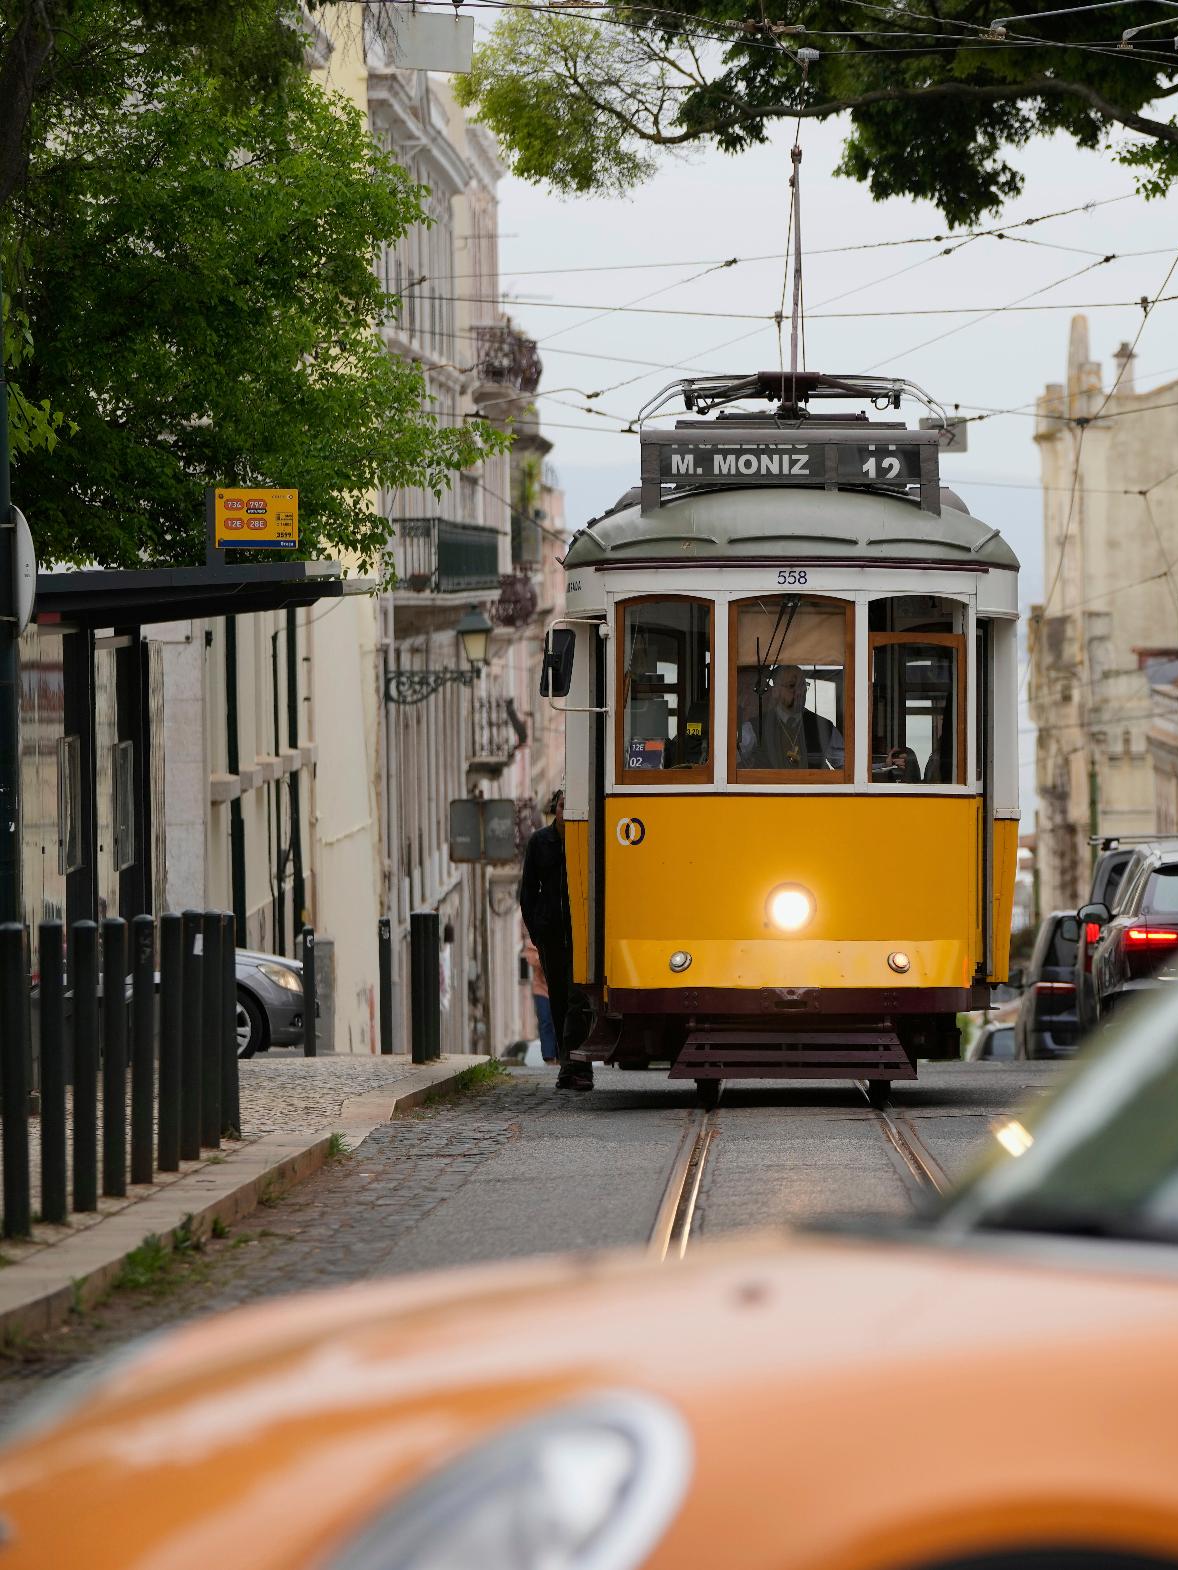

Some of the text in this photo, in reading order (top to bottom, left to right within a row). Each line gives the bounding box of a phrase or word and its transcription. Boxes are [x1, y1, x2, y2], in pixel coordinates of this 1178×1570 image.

[671, 454, 810, 475] M. MONIZ
[777, 570, 808, 585] 558
[629, 757, 643, 767] 02
